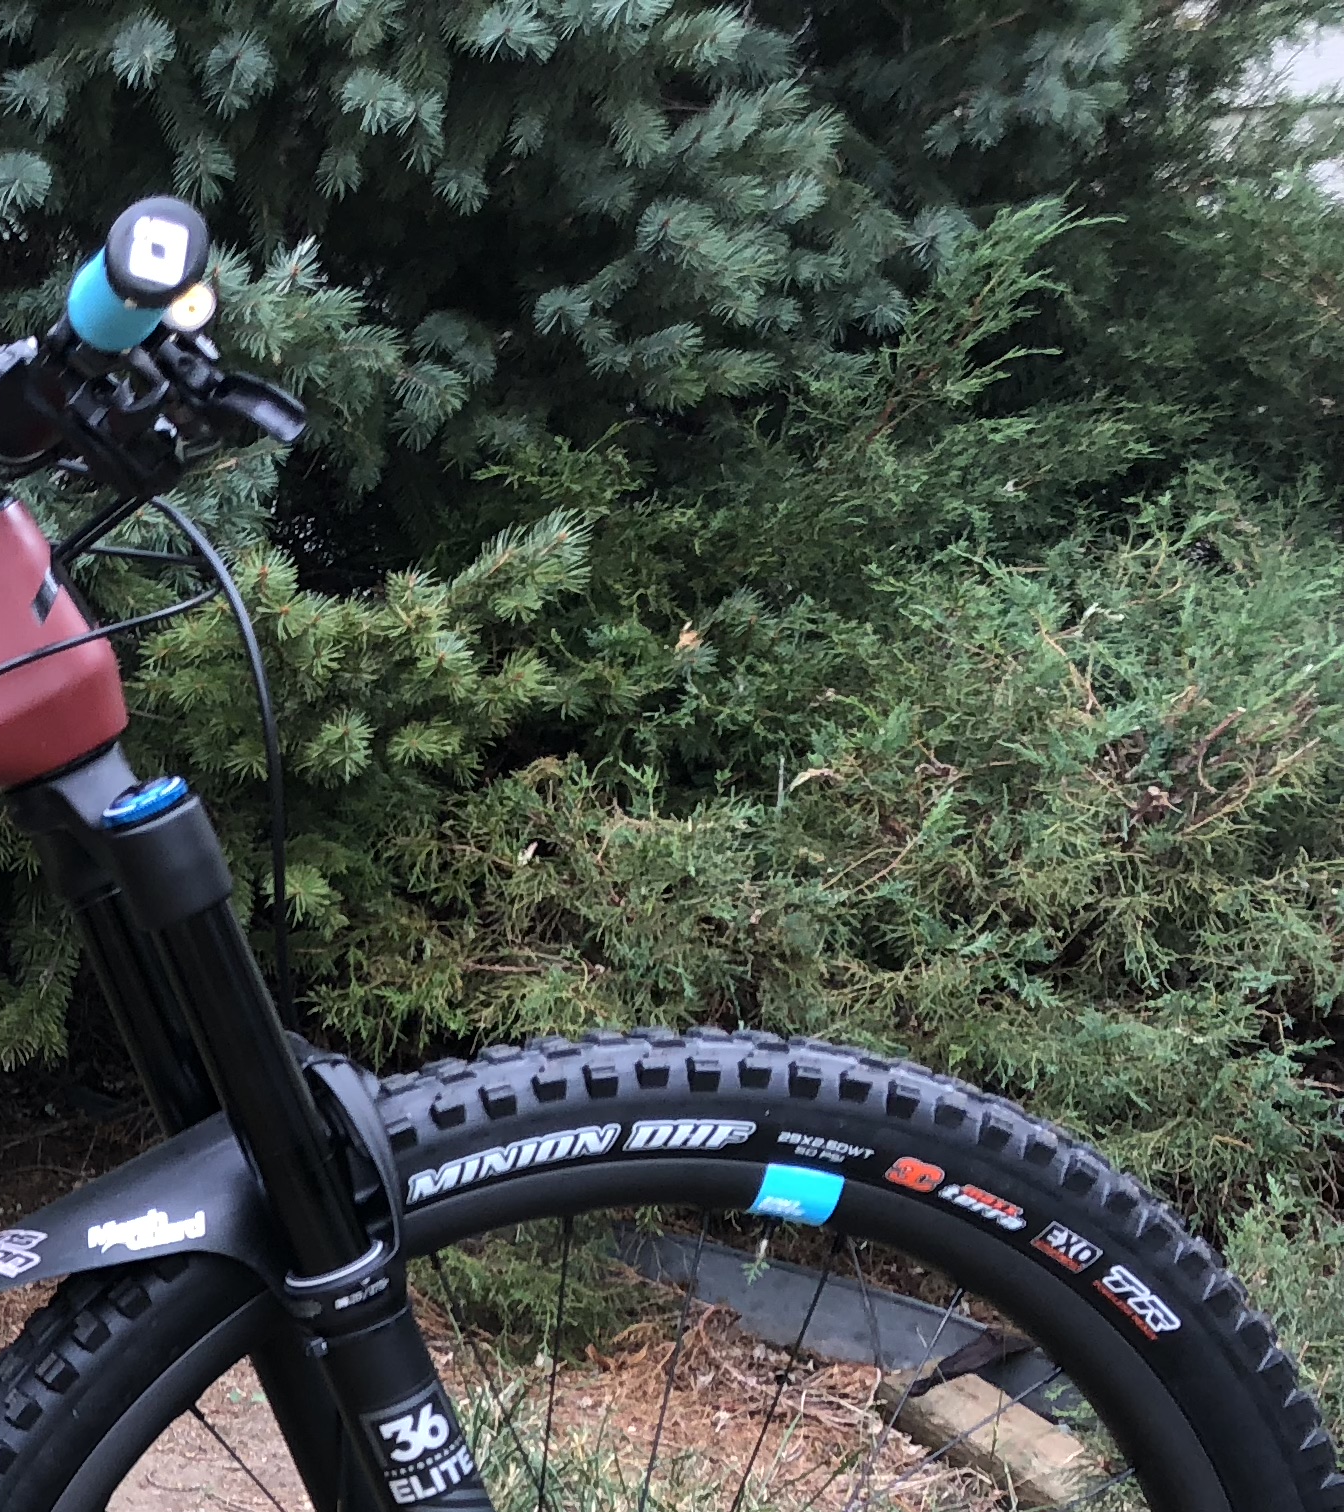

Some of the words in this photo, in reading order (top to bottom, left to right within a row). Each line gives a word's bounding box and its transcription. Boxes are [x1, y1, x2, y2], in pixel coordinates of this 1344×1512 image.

[406, 1123, 621, 1204] MINION
[623, 1120, 756, 1150] DHF
[1045, 1226, 1099, 1263] EXO
[1102, 1264, 1182, 1332] TR
[379, 1402, 450, 1463] 36
[389, 1444, 474, 1504] ELITE
